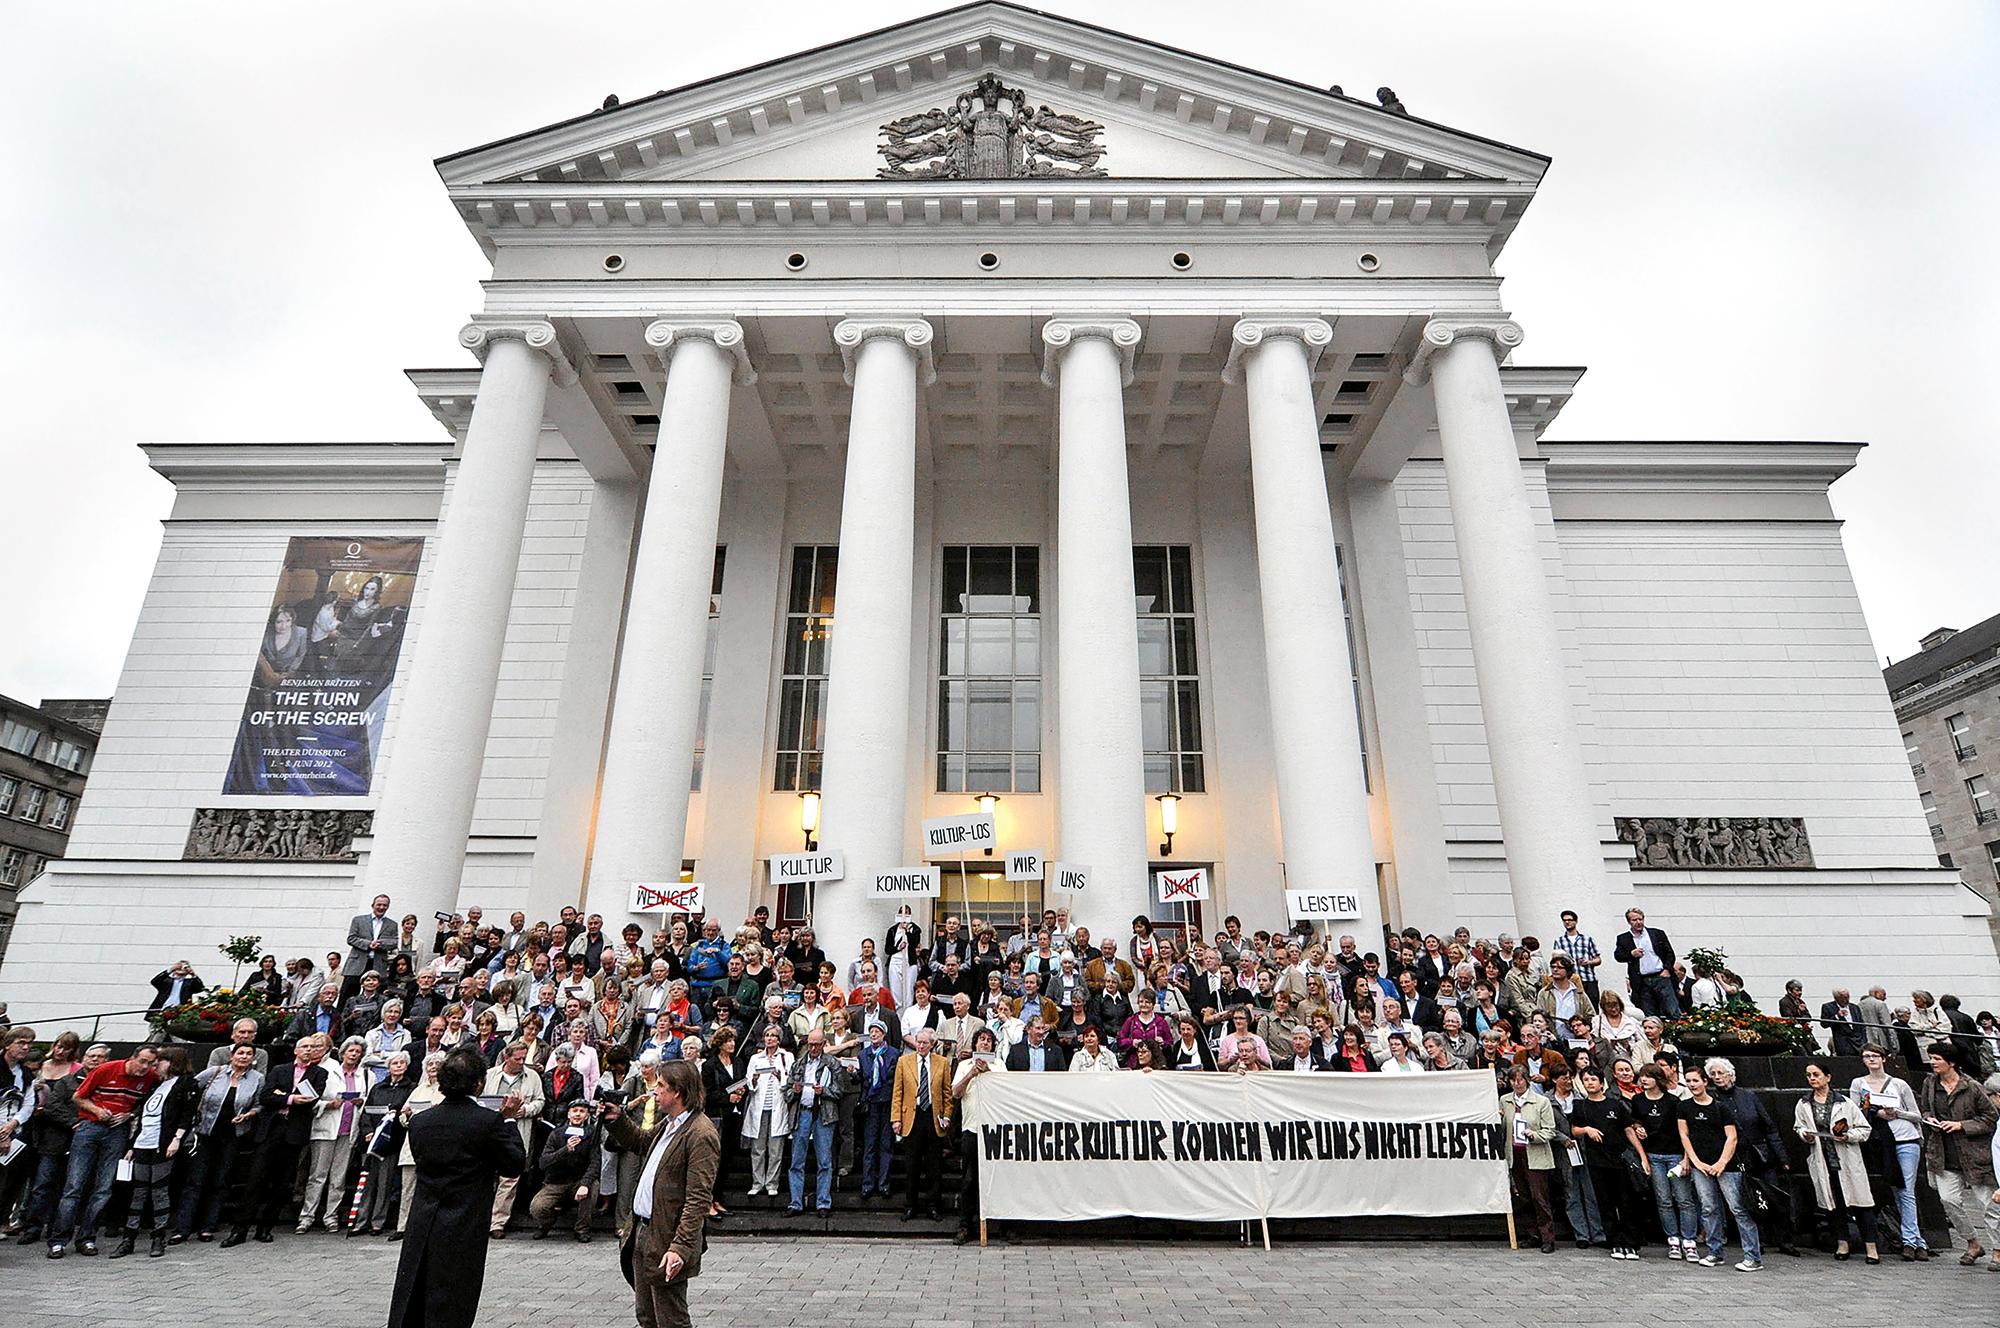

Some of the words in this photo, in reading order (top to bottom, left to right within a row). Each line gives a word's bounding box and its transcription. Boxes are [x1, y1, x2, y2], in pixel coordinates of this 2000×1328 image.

[275, 691, 310, 706] THE
[313, 692, 360, 706] TURN
[250, 711, 275, 725] OF
[276, 711, 313, 725] THE
[313, 712, 376, 726] SCREW
[262, 748, 301, 756] THEATER
[301, 749, 347, 757] DUISBURG
[292, 760, 313, 768] JUNI
[930, 823, 991, 846] KULTUR-LOS
[780, 857, 833, 877] KULTUR
[1013, 856, 1037, 873] WIR
[1060, 870, 1086, 890] UNS
[636, 890, 698, 906] WENIGER
[1298, 895, 1357, 913] LEISTEN
[981, 1123, 1080, 1161] WENIGER
[1080, 1120, 1168, 1161] KULTUR
[1172, 1120, 1262, 1161] KÖNNEN
[1264, 1120, 1314, 1161] WIR
[1315, 1121, 1362, 1160] UNS
[1363, 1121, 1423, 1161] NICHT
[1426, 1121, 1506, 1161] LEISTEN
